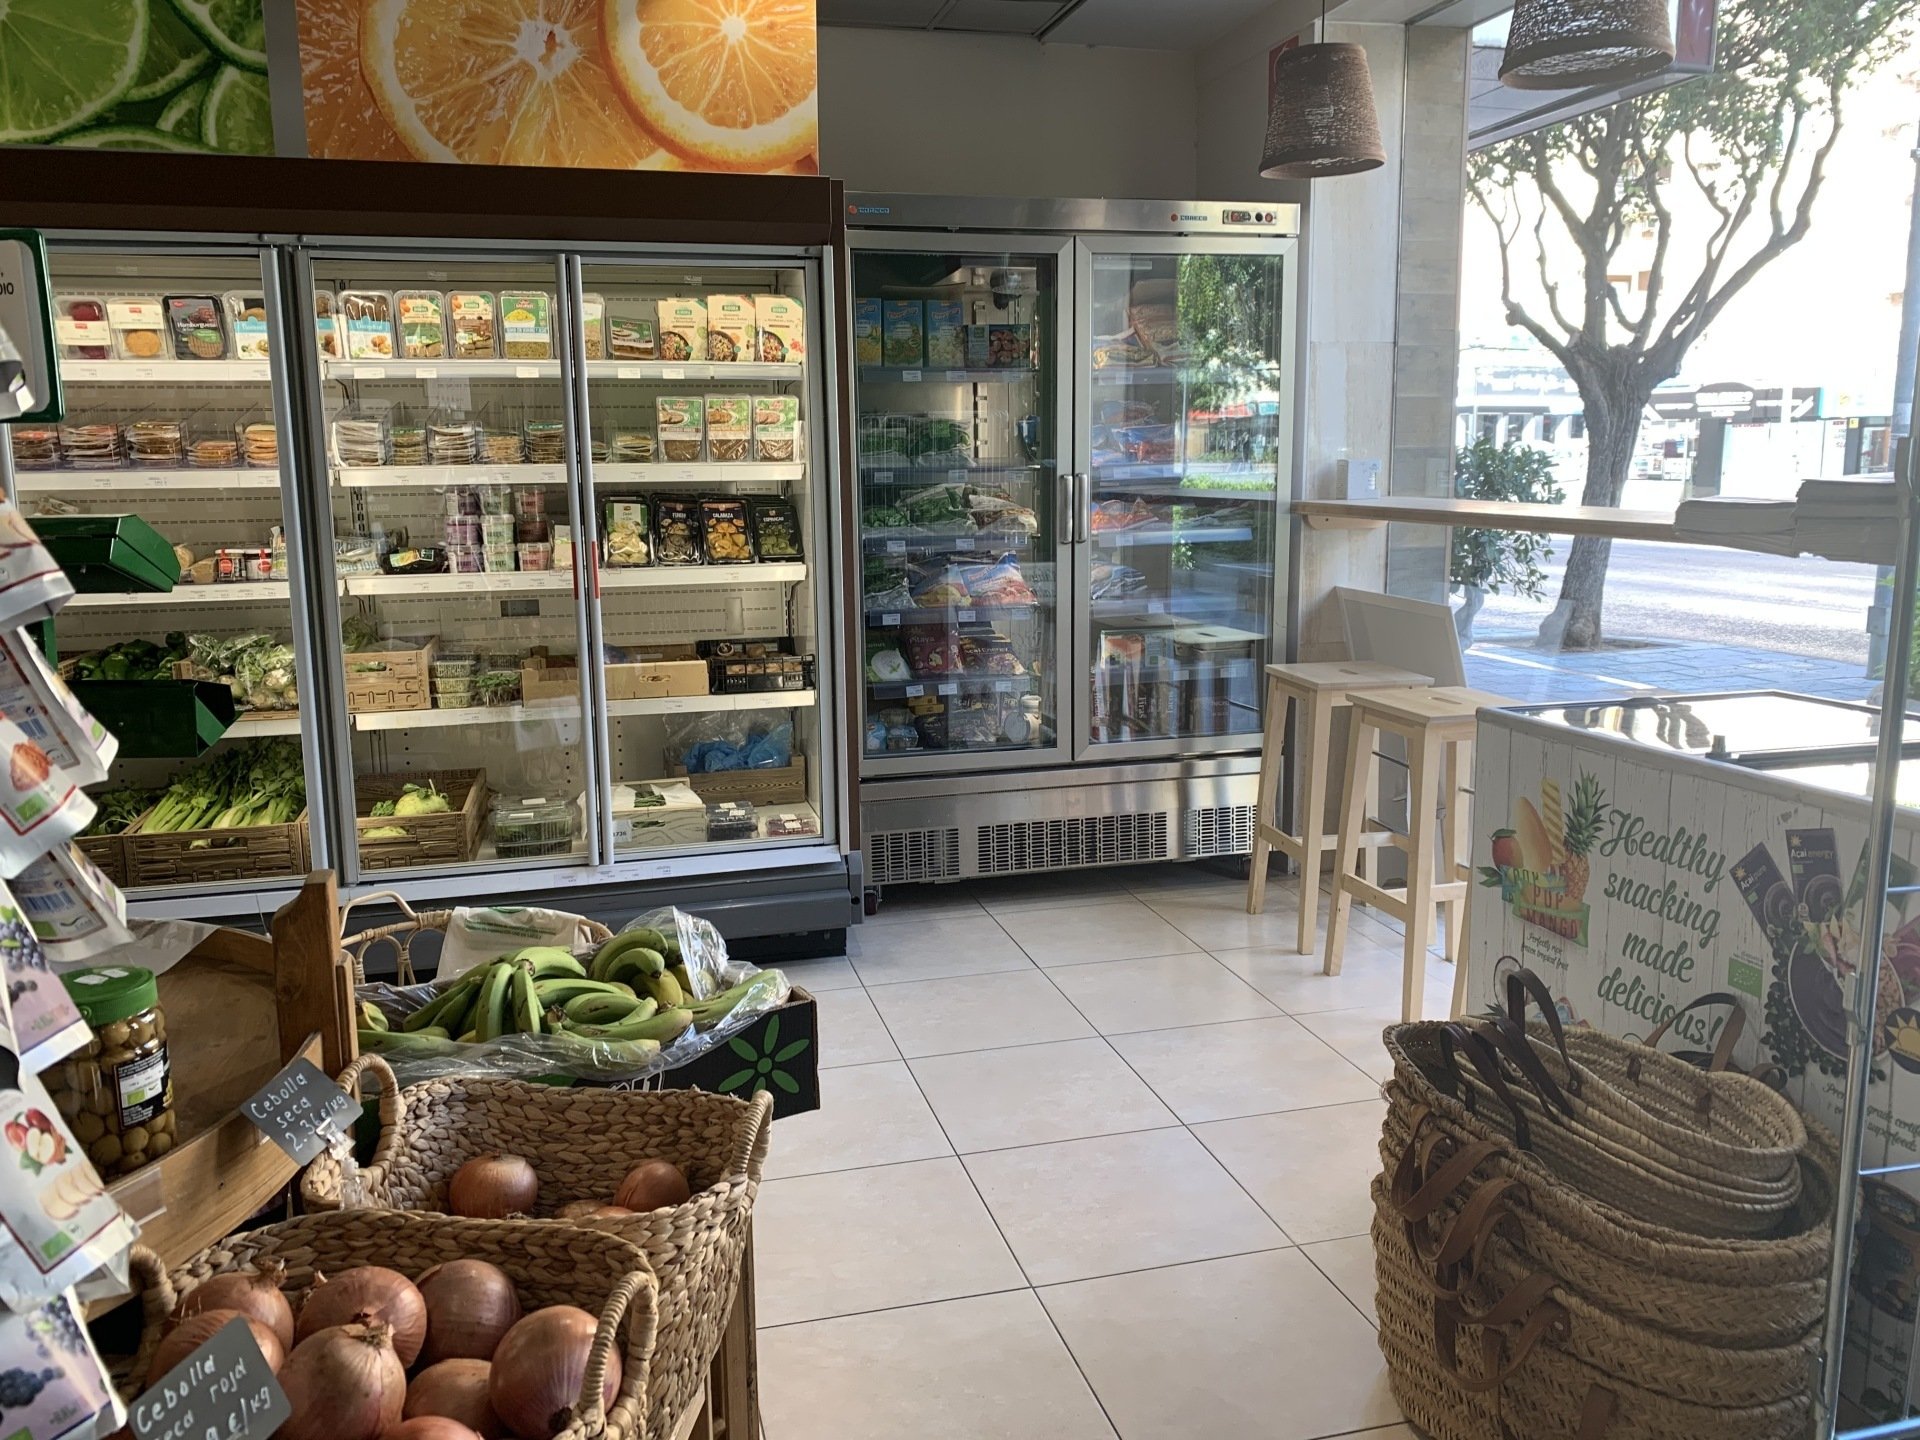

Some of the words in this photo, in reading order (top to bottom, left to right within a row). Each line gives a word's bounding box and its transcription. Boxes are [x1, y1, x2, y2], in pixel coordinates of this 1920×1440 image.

[1600, 809, 1726, 893] Healthy
[1603, 873, 1720, 949] snacking
[1622, 932, 1695, 983] made
[1597, 967, 1724, 1052] delicious!
[250, 1073, 308, 1119] Cebolla
[276, 1096, 312, 1128] seca
[136, 1354, 215, 1434] Cebolla
[209, 1357, 248, 1404] roja
